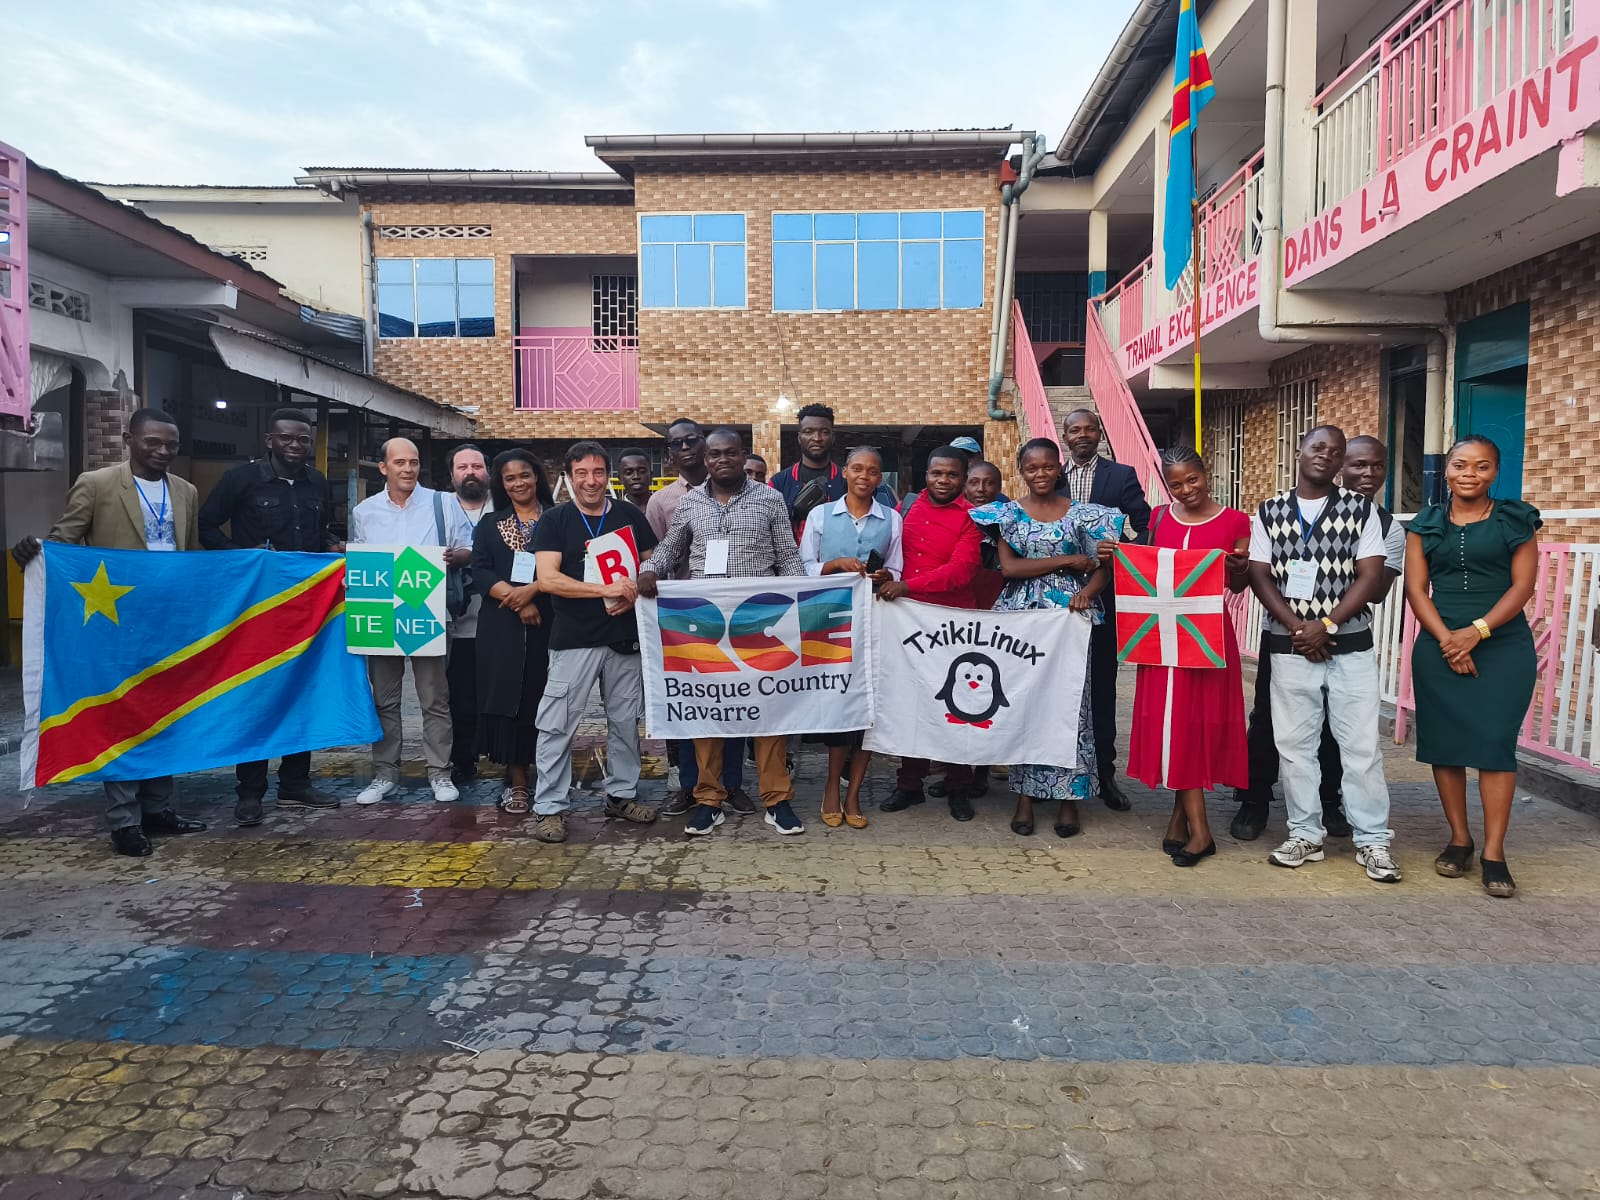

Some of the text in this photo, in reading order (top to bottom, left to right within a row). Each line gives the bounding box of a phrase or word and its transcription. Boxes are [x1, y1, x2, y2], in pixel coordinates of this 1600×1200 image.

[1285, 206, 1342, 278] DANS
[1361, 169, 1400, 233] LA
[1126, 324, 1163, 371] TRAVAIL
[348, 569, 432, 589] ELK AR
[350, 614, 439, 635] TE NET
[656, 586, 853, 673] RCE
[902, 620, 1046, 666] TxikiLinux
[664, 672, 853, 704] Basque Country
[666, 701, 761, 722] Navarre
